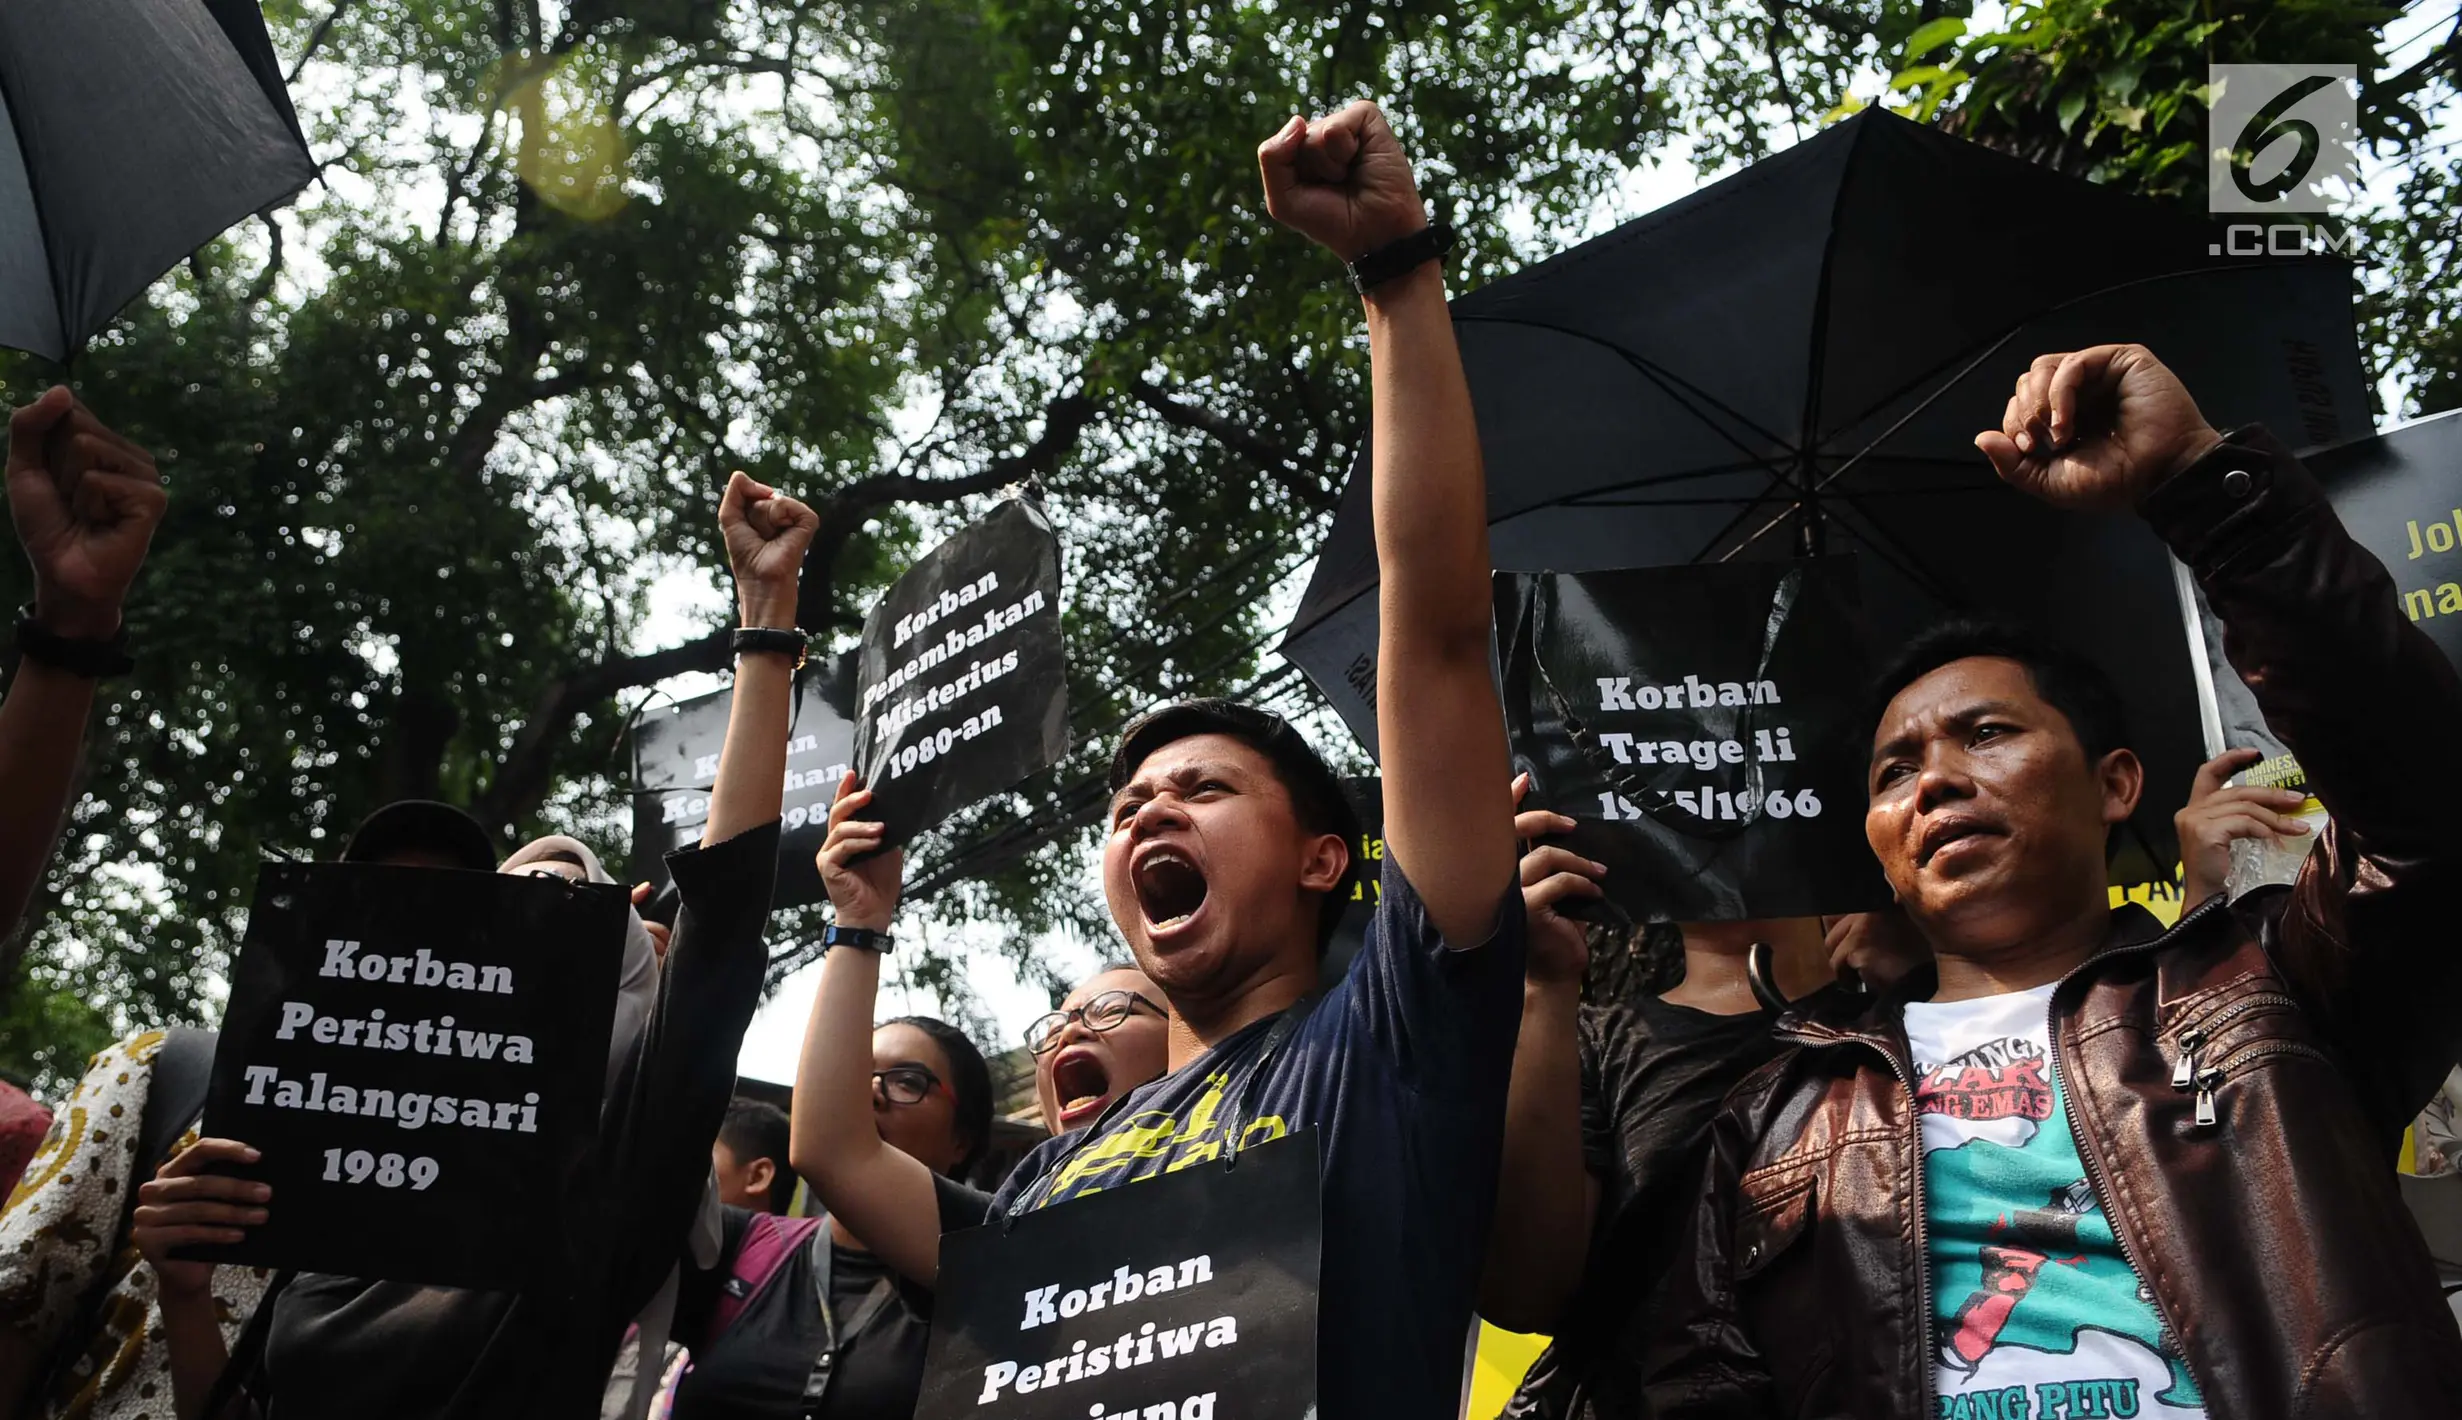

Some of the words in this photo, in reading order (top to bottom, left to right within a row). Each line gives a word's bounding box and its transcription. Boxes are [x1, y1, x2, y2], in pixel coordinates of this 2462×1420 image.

[892, 570, 999, 650] Korban
[861, 587, 1045, 717] Penembakan
[873, 650, 1019, 744] Misterius
[1596, 675, 1781, 713] Korban
[888, 702, 1004, 781] 1980-an
[319, 939, 514, 995] Korban
[275, 1002, 534, 1064] Peristiwa
[244, 1066, 540, 1133] Talangsari
[1971, 1090, 2054, 1120] EMAS
[322, 1148, 440, 1192] 1989
[1019, 1252, 1214, 1331] Korban
[977, 1315, 1238, 1405] Peristiwa
[2035, 1377, 2140, 1420] PITU
